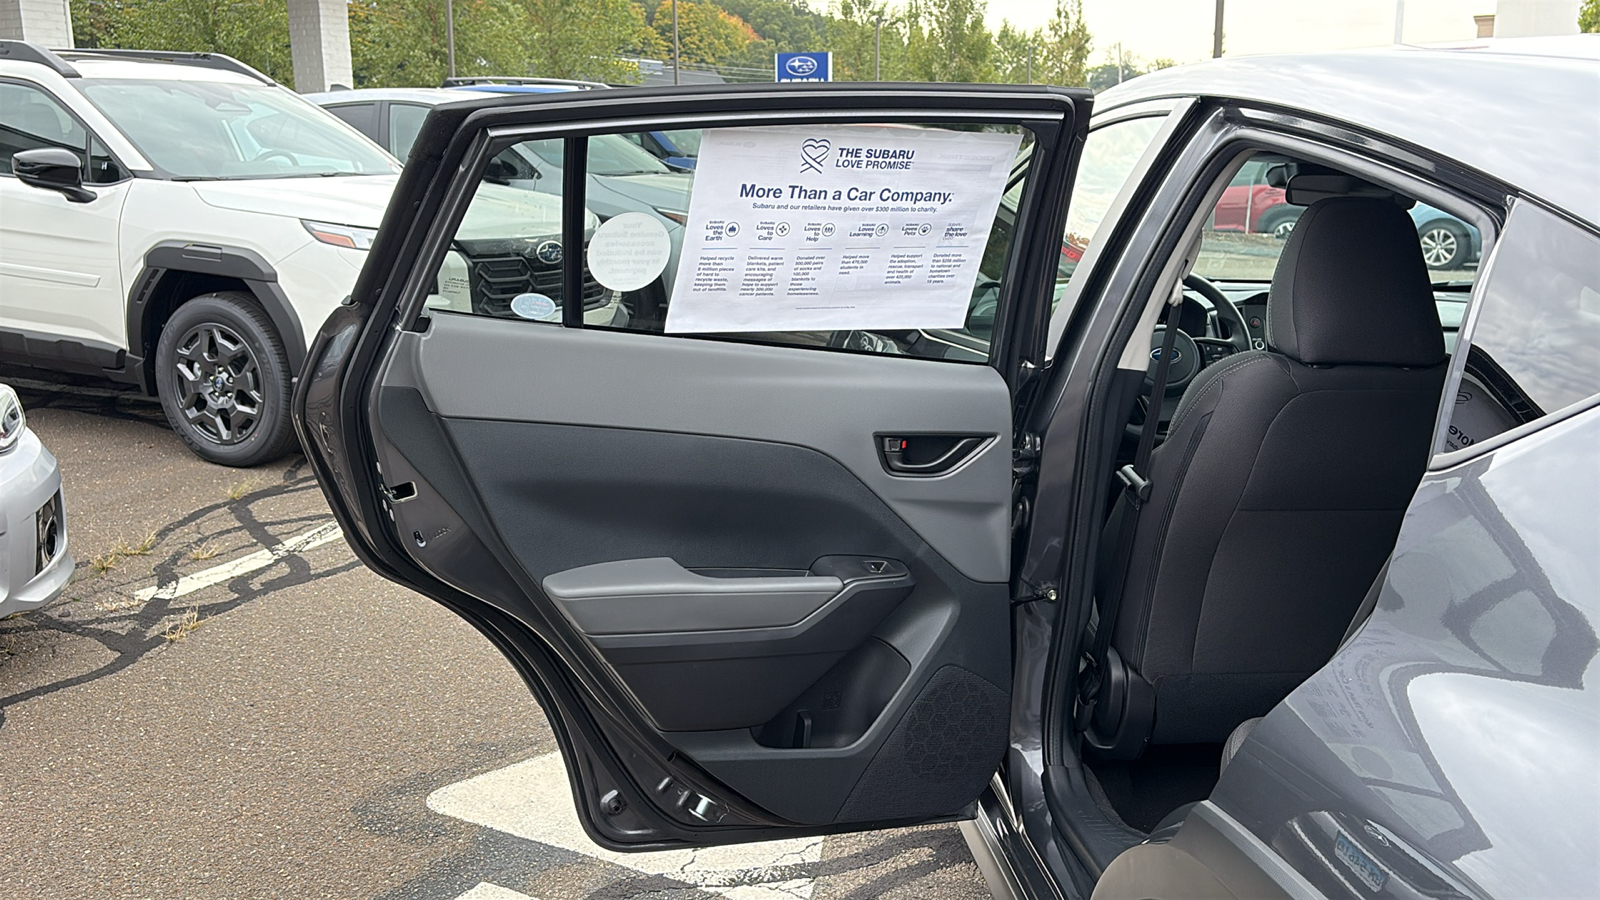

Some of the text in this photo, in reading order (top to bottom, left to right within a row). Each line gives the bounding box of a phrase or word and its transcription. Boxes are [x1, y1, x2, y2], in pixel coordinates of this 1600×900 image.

[838, 148, 915, 159] THE SUBARU
[836, 159, 862, 169] LOVE
[740, 184, 783, 198] More
[789, 185, 828, 200] Than
[832, 190, 842, 201] a
[847, 187, 875, 202] Car
